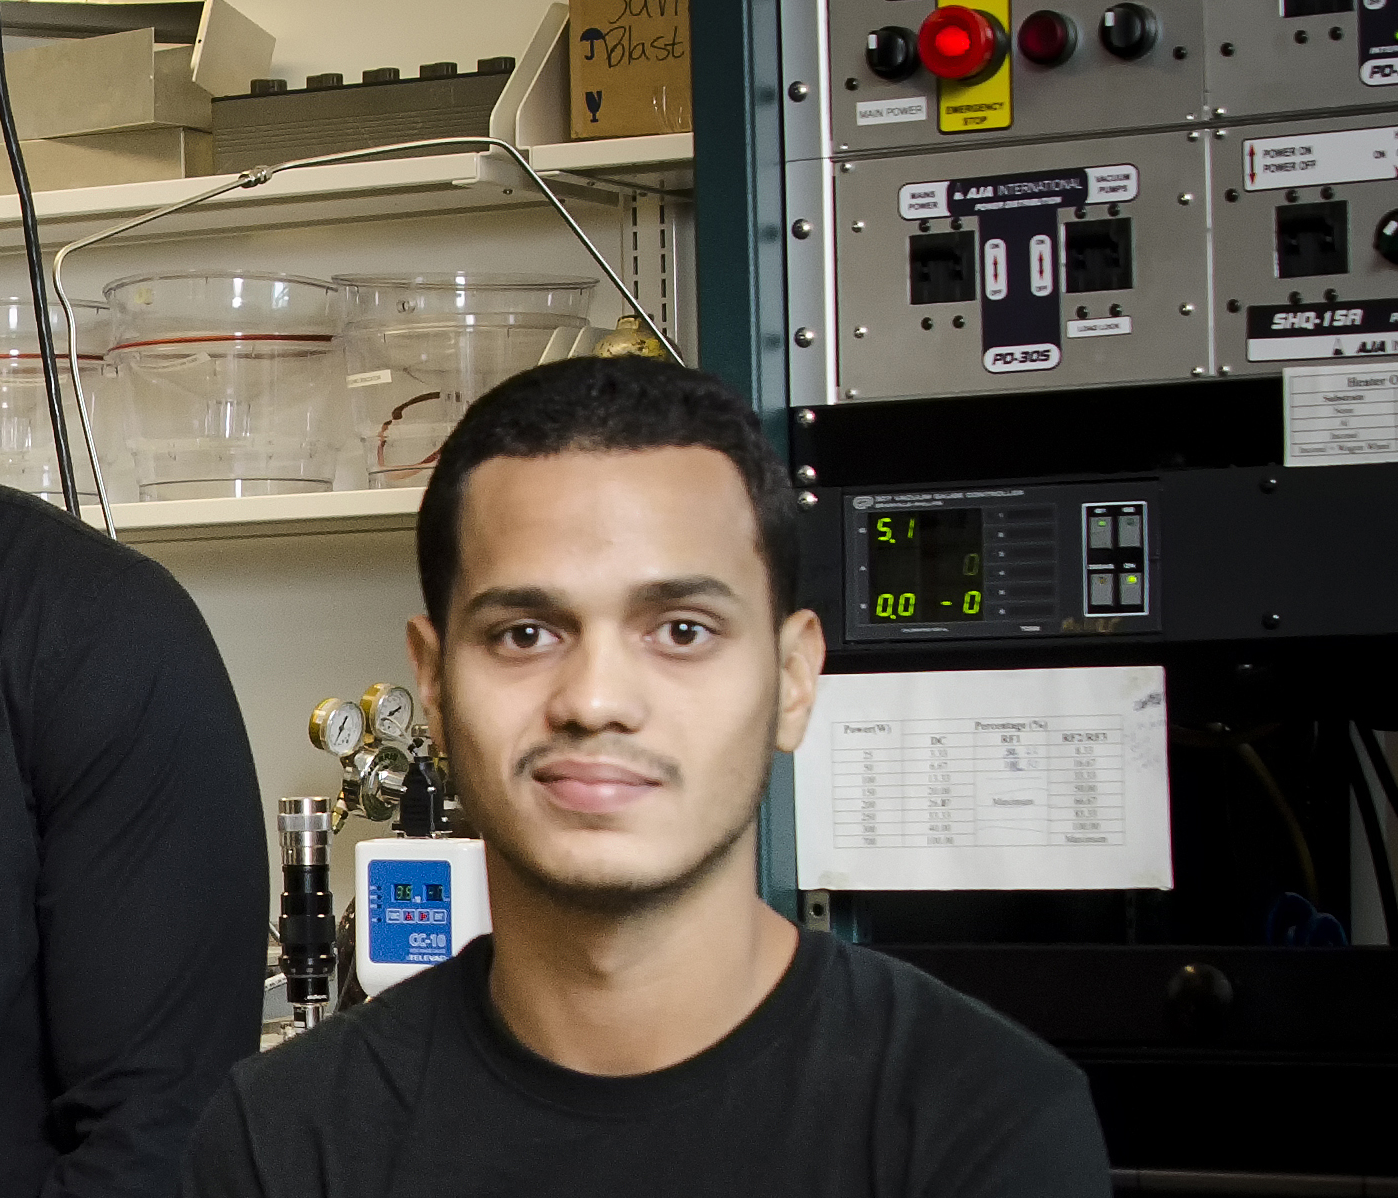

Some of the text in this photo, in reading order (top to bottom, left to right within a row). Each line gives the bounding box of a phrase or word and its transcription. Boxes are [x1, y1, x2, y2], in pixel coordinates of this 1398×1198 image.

[604, 25, 684, 69] Blast
[858, 105, 923, 119] MAIN POWER
[945, 102, 1004, 115] EMERGENCY
[1263, 147, 1296, 158] POWER
[1263, 162, 1296, 173] POWER
[1094, 173, 1132, 183] VACUUM
[997, 178, 1083, 196] INTERNATIONAL
[1097, 185, 1128, 193] PUMPS
[908, 201, 939, 210] POWER
[975, 721, 1026, 732] Percentage
[409, 933, 447, 948] CC-10
